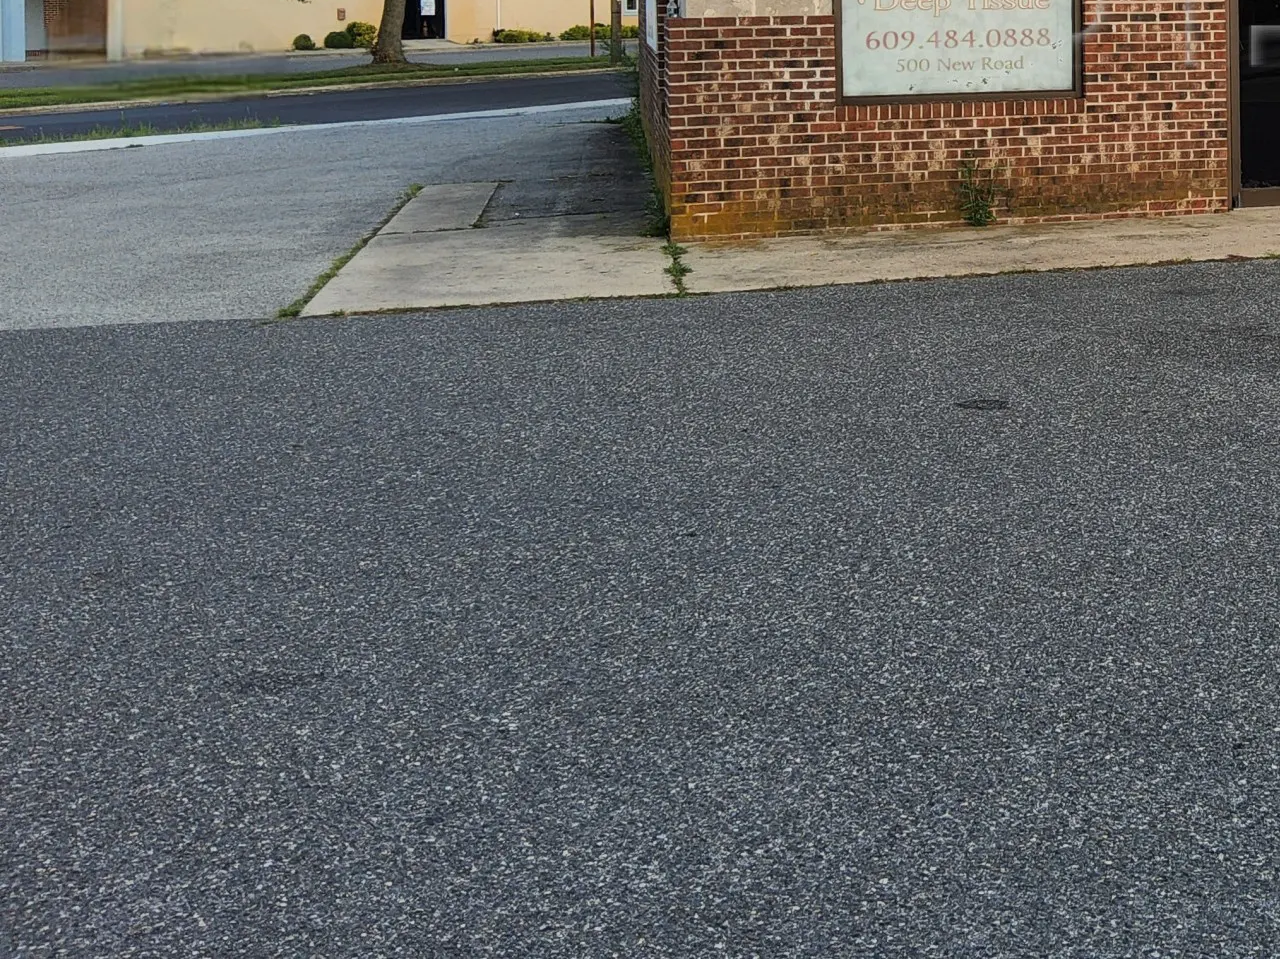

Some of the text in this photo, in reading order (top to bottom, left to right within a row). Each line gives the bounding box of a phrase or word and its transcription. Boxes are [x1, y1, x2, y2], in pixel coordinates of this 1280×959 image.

[865, 28, 1051, 51] 609.484.0888
[896, 56, 1025, 73] 500 New Road
